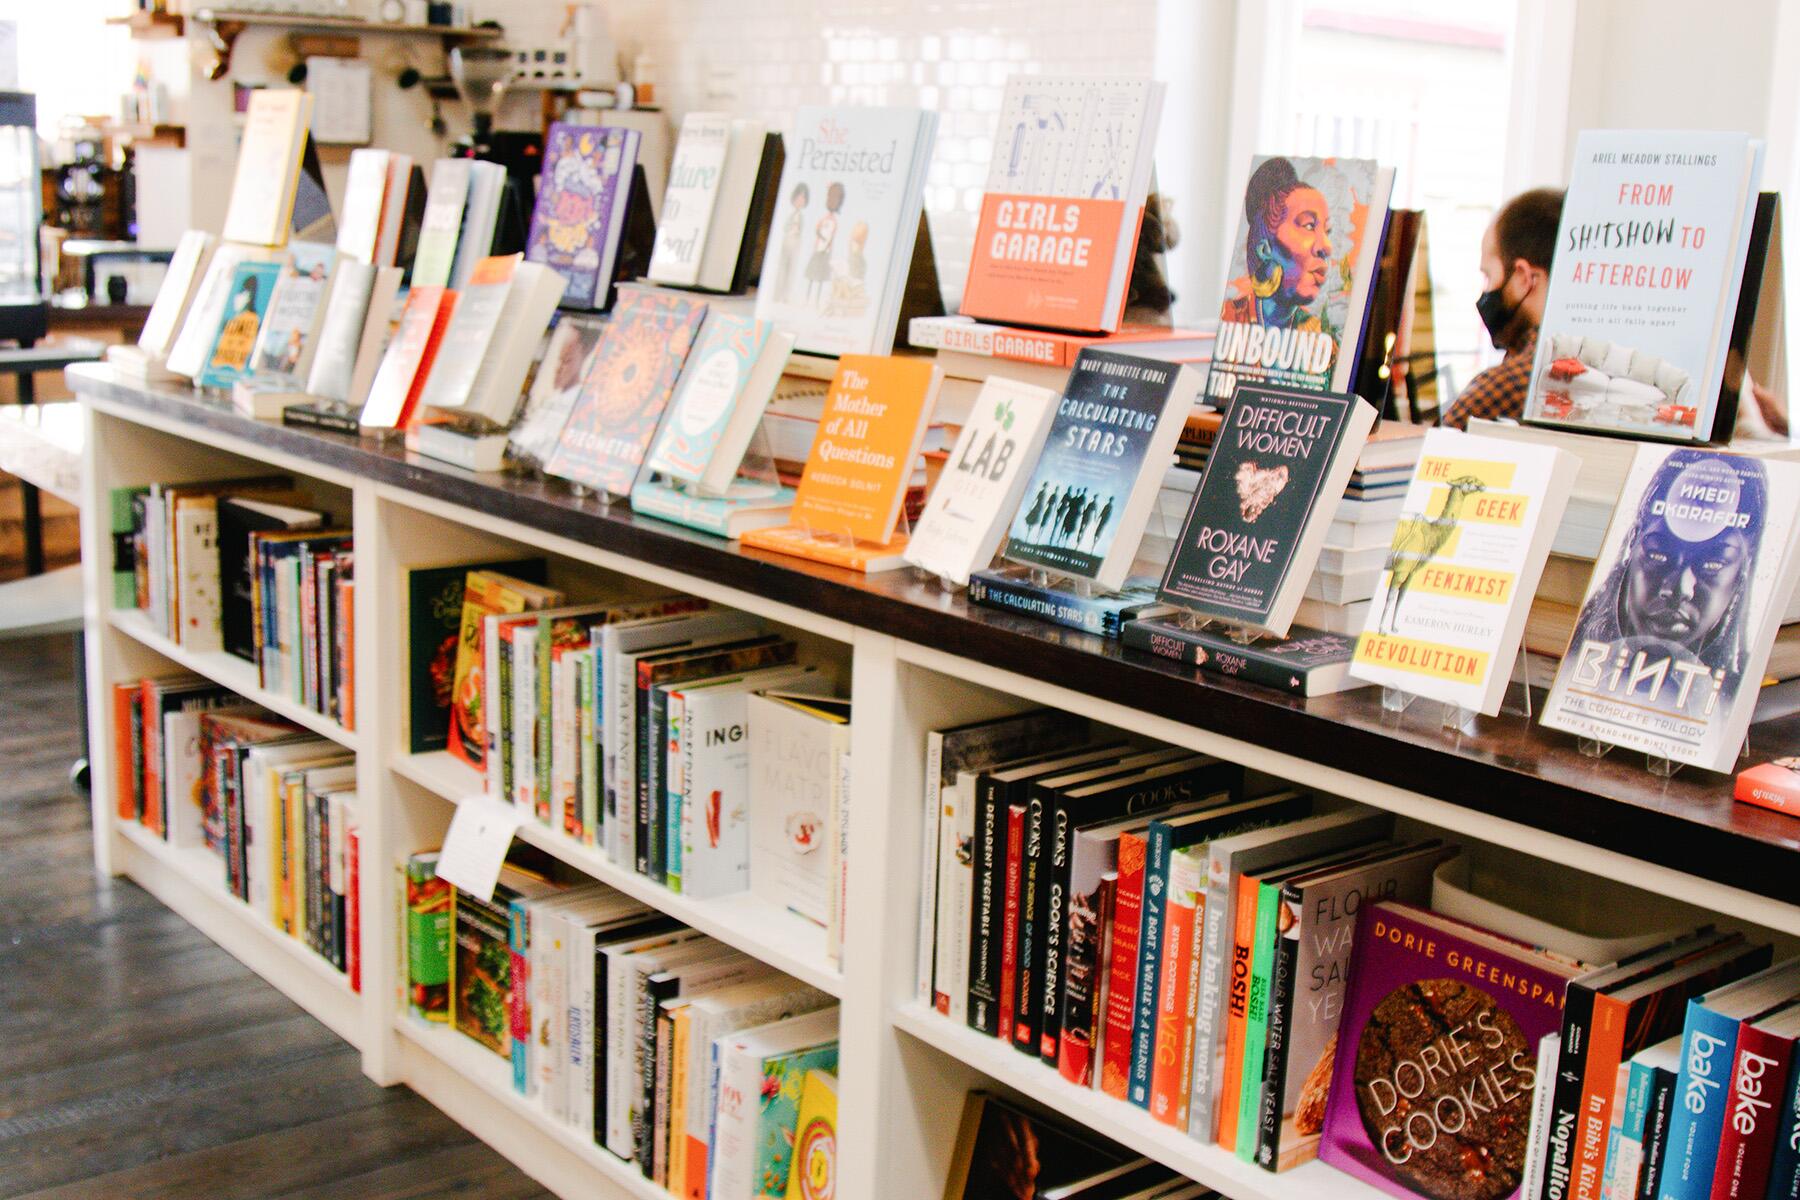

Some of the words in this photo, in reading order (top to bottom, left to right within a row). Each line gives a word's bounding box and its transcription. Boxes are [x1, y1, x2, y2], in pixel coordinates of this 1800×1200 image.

[817, 118, 848, 145] She
[797, 137, 897, 174] Persisted
[1592, 152, 1617, 165] ARIEL
[1620, 153, 1661, 166] MEADOW
[1664, 154, 1718, 167] STALLINGS
[1618, 184, 1674, 206] FROM
[996, 200, 1081, 233] GIRLS
[990, 232, 1092, 268] GARAGE
[1569, 218, 1675, 252] SH!TSHOW
[1681, 226, 1706, 249] TO
[1572, 262, 1692, 290] AFTERGLOW
[944, 329, 991, 351] GIRLS
[994, 332, 1055, 361] GARAGE
[1214, 322, 1333, 373] UNBOUND
[842, 370, 868, 390] The
[1080, 359, 1102, 372] MARY
[1103, 362, 1140, 381] ROBINETTE
[832, 395, 888, 417] Mother
[1103, 384, 1128, 399] THE
[825, 417, 842, 435] of
[843, 421, 868, 440] All
[1059, 399, 1156, 432] CALCULATING
[1237, 406, 1332, 440] DIFFICULT
[819, 440, 895, 470] Questions
[957, 429, 1016, 482] LAB
[1064, 426, 1128, 458] STARS
[1238, 430, 1313, 459] WOMEN
[1424, 460, 1451, 478] THE
[1475, 499, 1522, 521] GEEK
[1651, 500, 1750, 530] OKORAFOR
[1196, 526, 1278, 564] ROXANE
[1208, 556, 1252, 581] GAY
[1422, 569, 1508, 598] FEMINIST
[988, 589, 1002, 602] THE
[1004, 592, 1057, 617] CALCULATING
[1058, 606, 1085, 624] STARS
[1151, 634, 1186, 652] DIFFICULT
[1404, 614, 1450, 632] KAMERON
[1453, 620, 1494, 638] HURLEY
[1152, 644, 1182, 660] WOMEN
[1215, 652, 1248, 670] ROXANE
[1222, 663, 1239, 676] GAY
[1364, 638, 1478, 677] REVOLUTION
[1564, 695, 1586, 708] THE
[1588, 700, 1652, 727] COMPLETE
[1654, 717, 1706, 738] TRILOGY
[986, 786, 995, 802] THE
[984, 803, 995, 868] DECADENT
[1028, 798, 1043, 859] COOK'S
[1053, 808, 1068, 868] COOK'S
[1008, 862, 1020, 898] tahini
[1027, 860, 1037, 880] THE
[980, 871, 994, 936] VEGETABLE
[1026, 880, 1036, 922] SCIENCE
[1048, 883, 1062, 946] COOK'S
[1004, 912, 1016, 965] turmeric
[1169, 926, 1181, 960] RIVER
[1190, 904, 1204, 959] CULINARY
[1208, 908, 1224, 950] how
[1374, 920, 1436, 958] DORIE
[1022, 936, 1033, 968] GOOD
[1043, 950, 1060, 1016] SCIENCE
[1141, 964, 1156, 1006] WHALE
[1164, 960, 1179, 1014] COTTAGE
[1230, 944, 1250, 1018] BOSH!
[1275, 950, 1290, 998] FLOUR
[1020, 969, 1031, 1016] COOKING
[1186, 966, 1200, 1018] REACTIONS
[1196, 954, 1221, 1034] baking
[1248, 972, 1262, 1021] BOSH!
[568, 1006, 583, 1066] JERUSALEM
[1158, 1014, 1179, 1067] VEG
[1270, 1004, 1285, 1050] WATER
[1136, 1032, 1150, 1082] WALRUS
[1194, 1036, 1211, 1094] works
[1268, 1054, 1281, 1088] SALT
[1368, 1010, 1505, 1117] DORIE'S
[1684, 1030, 1727, 1115] bake
[1382, 1052, 1537, 1165] COOKIES
[1588, 1094, 1606, 1113] In
[1657, 1088, 1668, 1111] Vegan
[1732, 1049, 1779, 1136] bake
[1264, 1090, 1278, 1134] YEAST
[1654, 1112, 1665, 1140] Richa's
[1548, 1109, 1576, 1200] Nopalito
[1582, 1116, 1604, 1161] Bibi's
[1650, 1140, 1661, 1166] Indian
[1685, 1121, 1697, 1156] VOLUME
[1682, 1156, 1692, 1181] FOUR
[1732, 1142, 1746, 1178] VOLUME
[1644, 1166, 1657, 1196] Kitchen
[1729, 1178, 1739, 1198] ONE
